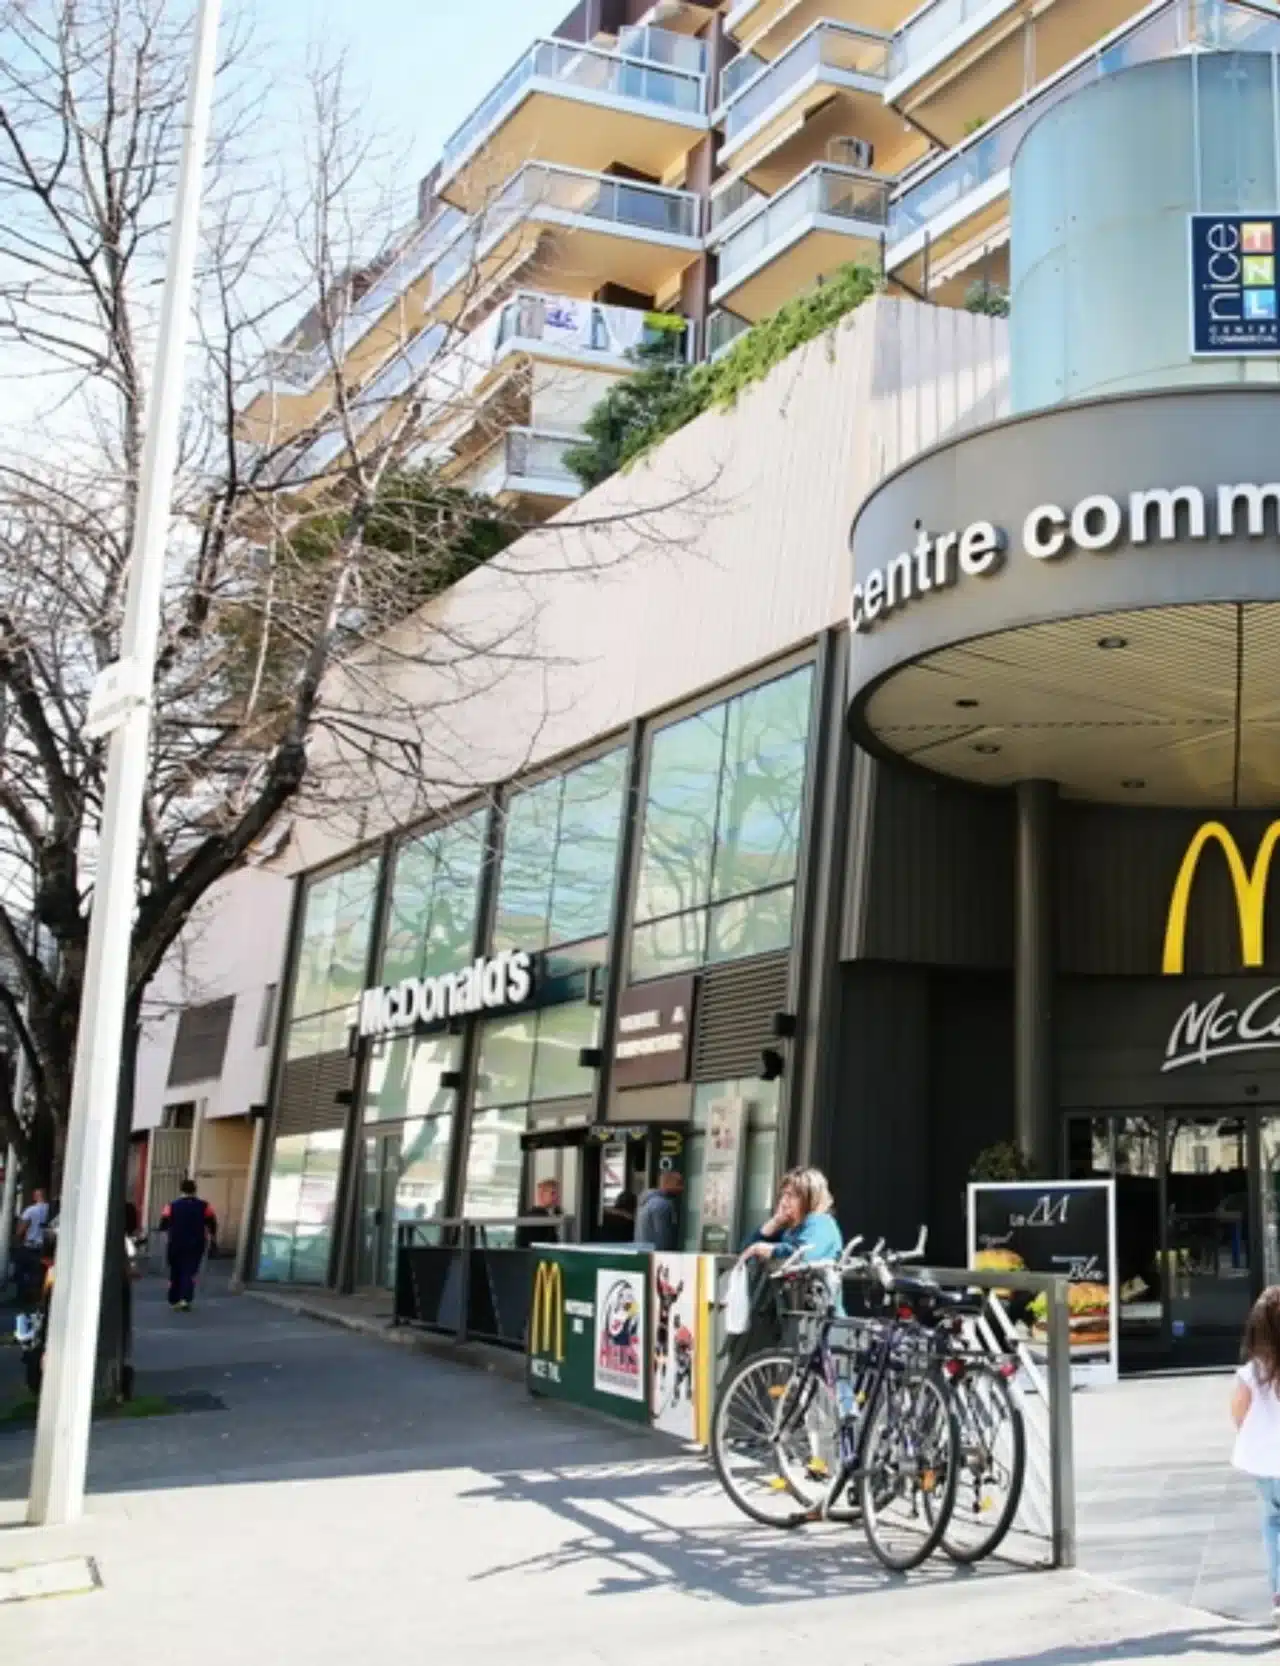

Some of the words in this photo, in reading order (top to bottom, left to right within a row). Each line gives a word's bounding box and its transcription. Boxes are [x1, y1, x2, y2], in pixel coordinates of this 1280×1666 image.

[1203, 223, 1241, 320] nice
[850, 519, 1002, 634] centre
[359, 950, 531, 1036] McDonald's
